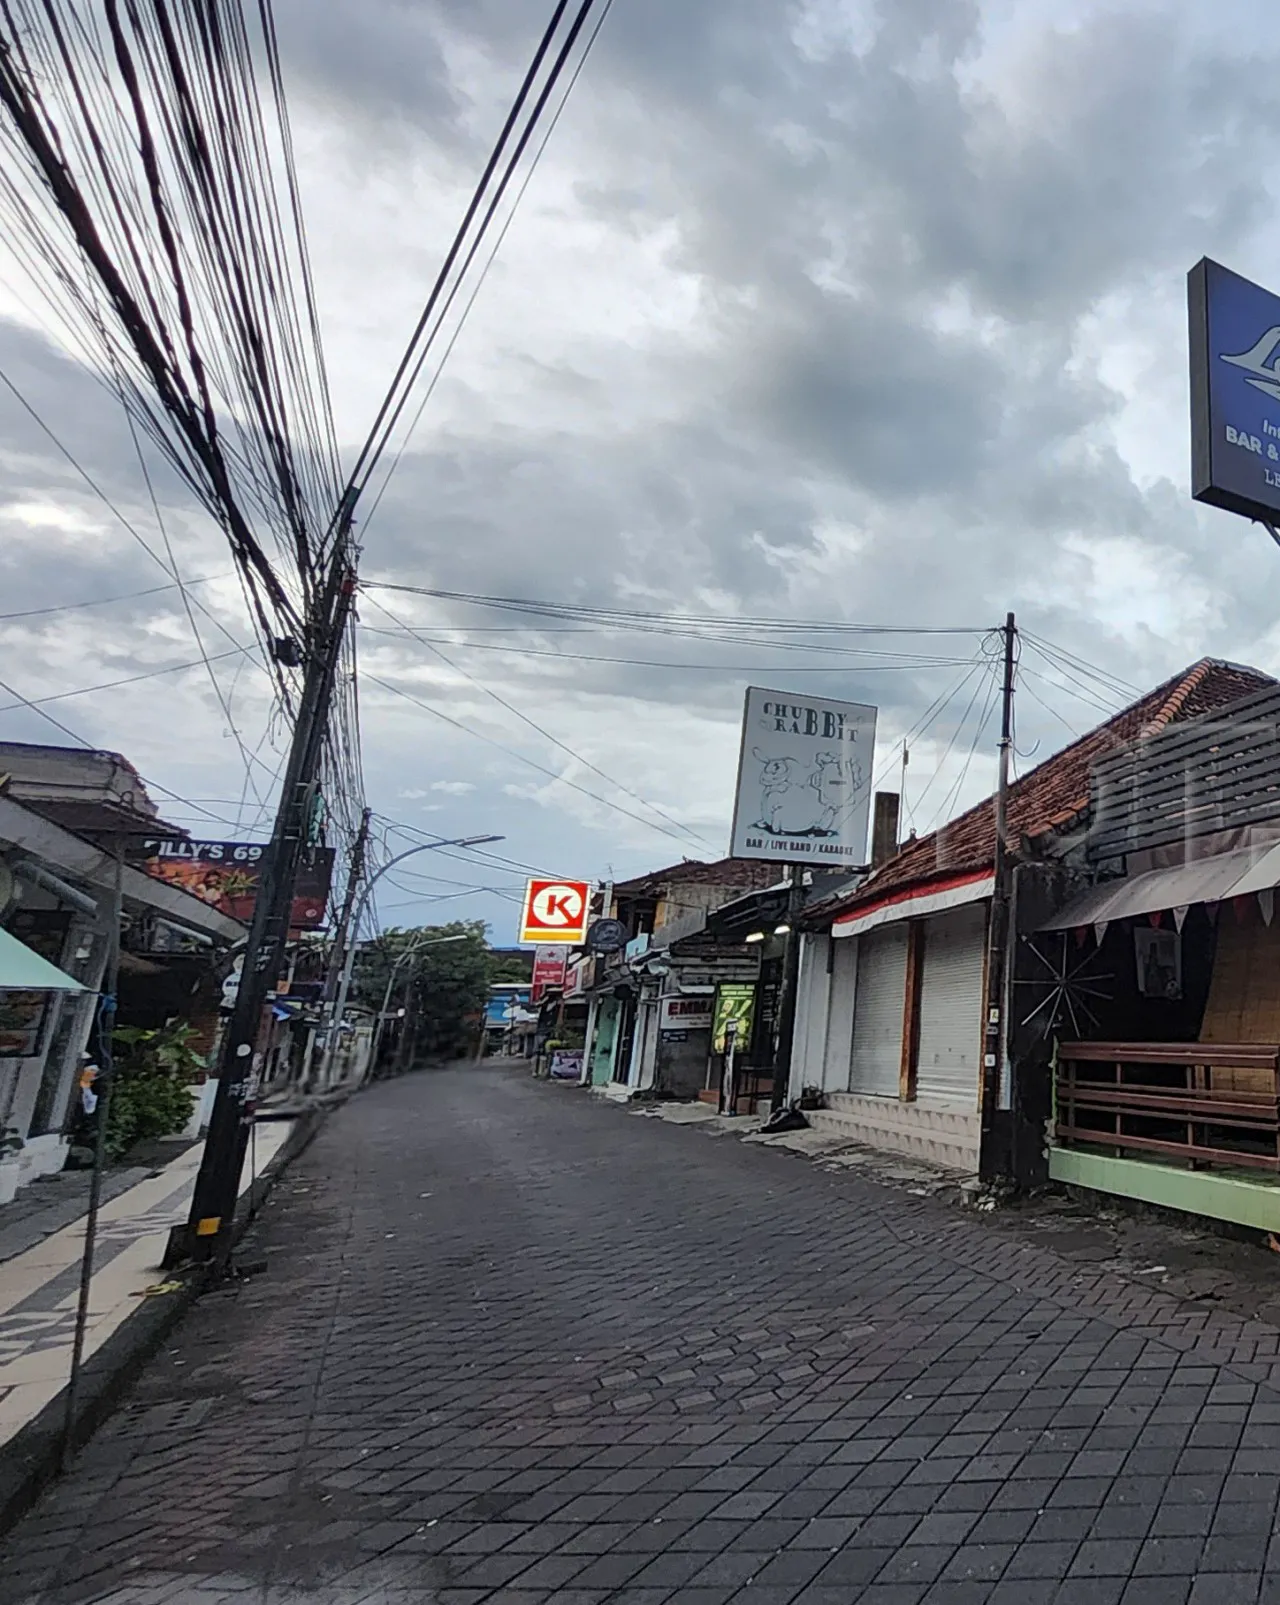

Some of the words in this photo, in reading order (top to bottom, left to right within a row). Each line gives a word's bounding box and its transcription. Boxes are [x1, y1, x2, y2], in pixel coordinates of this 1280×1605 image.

[1226, 425, 1262, 455] BAR
[1267, 442, 1279, 461] &
[763, 702, 847, 738] CHUBBY
[775, 708, 859, 742] RABBIT
[233, 846, 262, 861] 69
[746, 838, 762, 849] BAR
[771, 840, 788, 851] LIVE
[790, 842, 811, 853] BAND
[819, 844, 854, 856] KARAOKE
[547, 894, 574, 925] K
